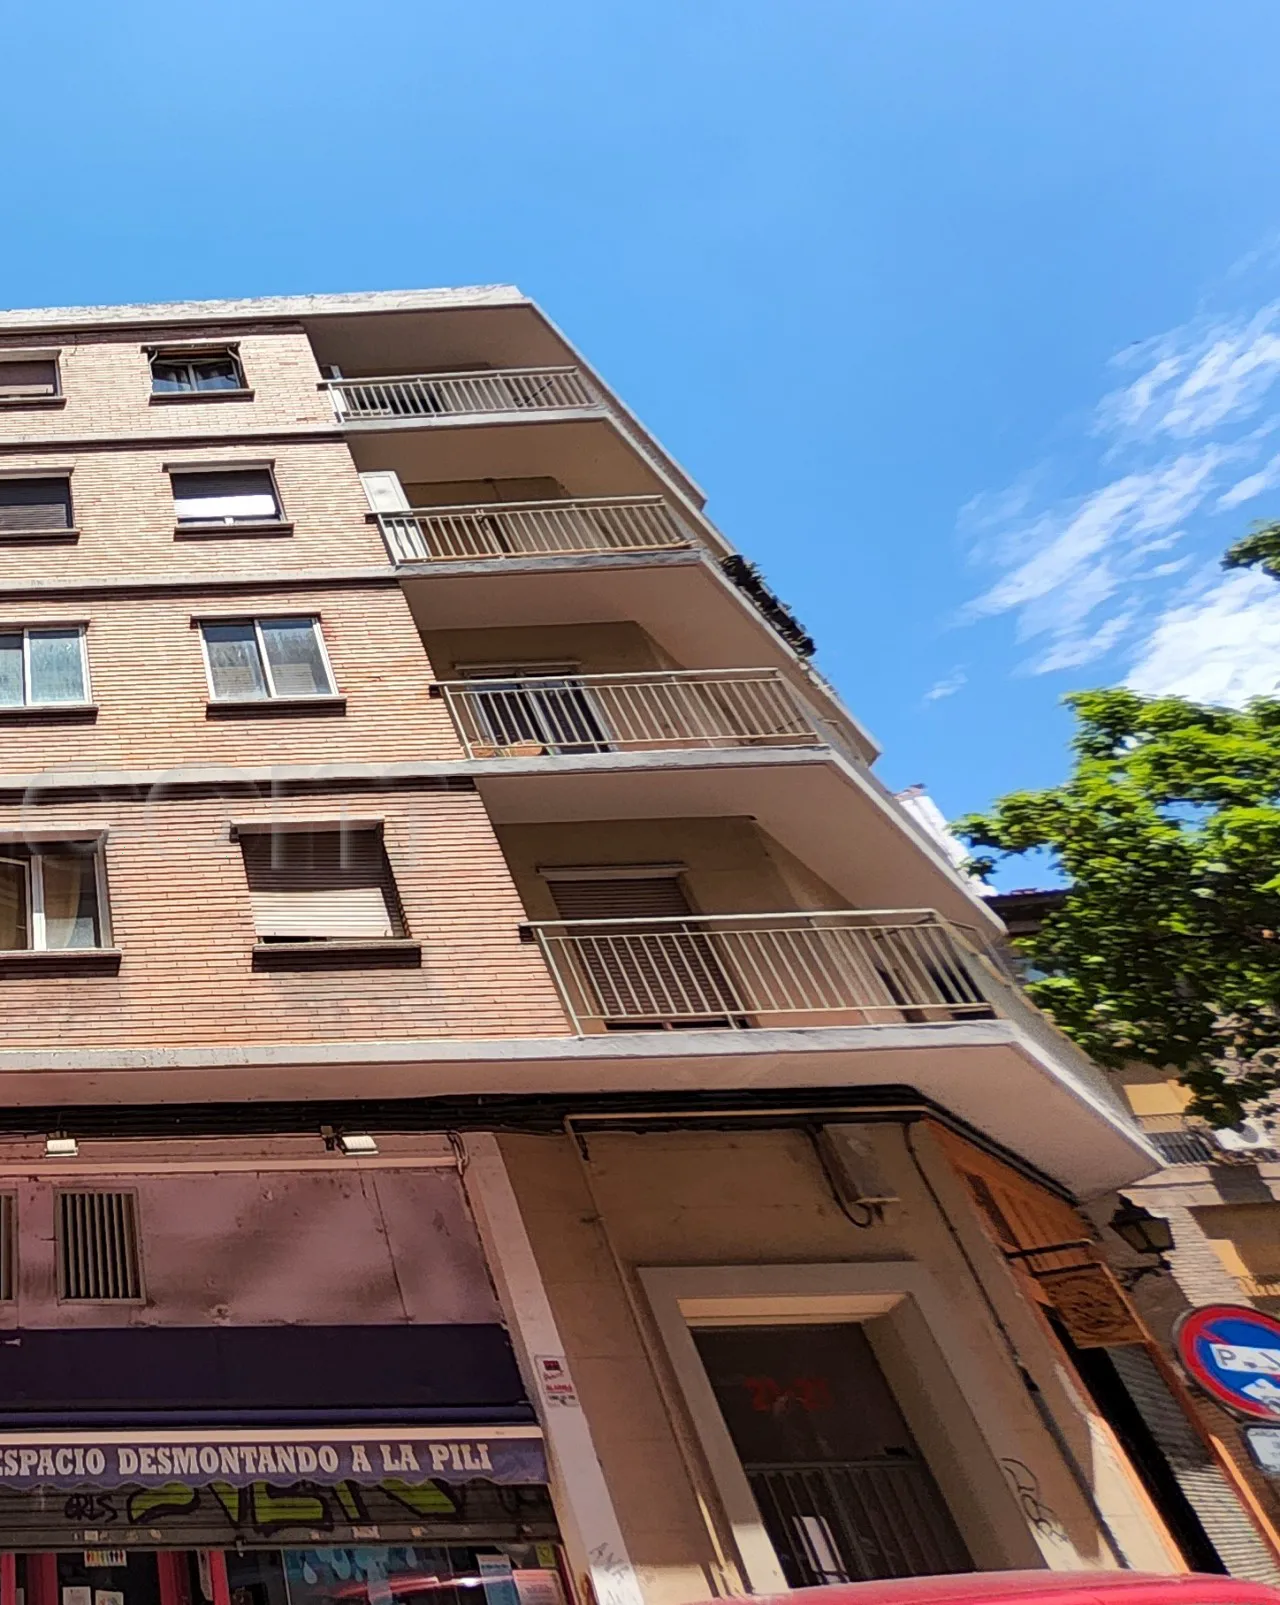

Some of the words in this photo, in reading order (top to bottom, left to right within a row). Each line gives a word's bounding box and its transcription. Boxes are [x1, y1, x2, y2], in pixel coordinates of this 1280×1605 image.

[118, 1446, 339, 1475] DESMONTANDO
[351, 1444, 372, 1473] A
[380, 1444, 420, 1472] LA
[428, 1443, 495, 1472] PILI
